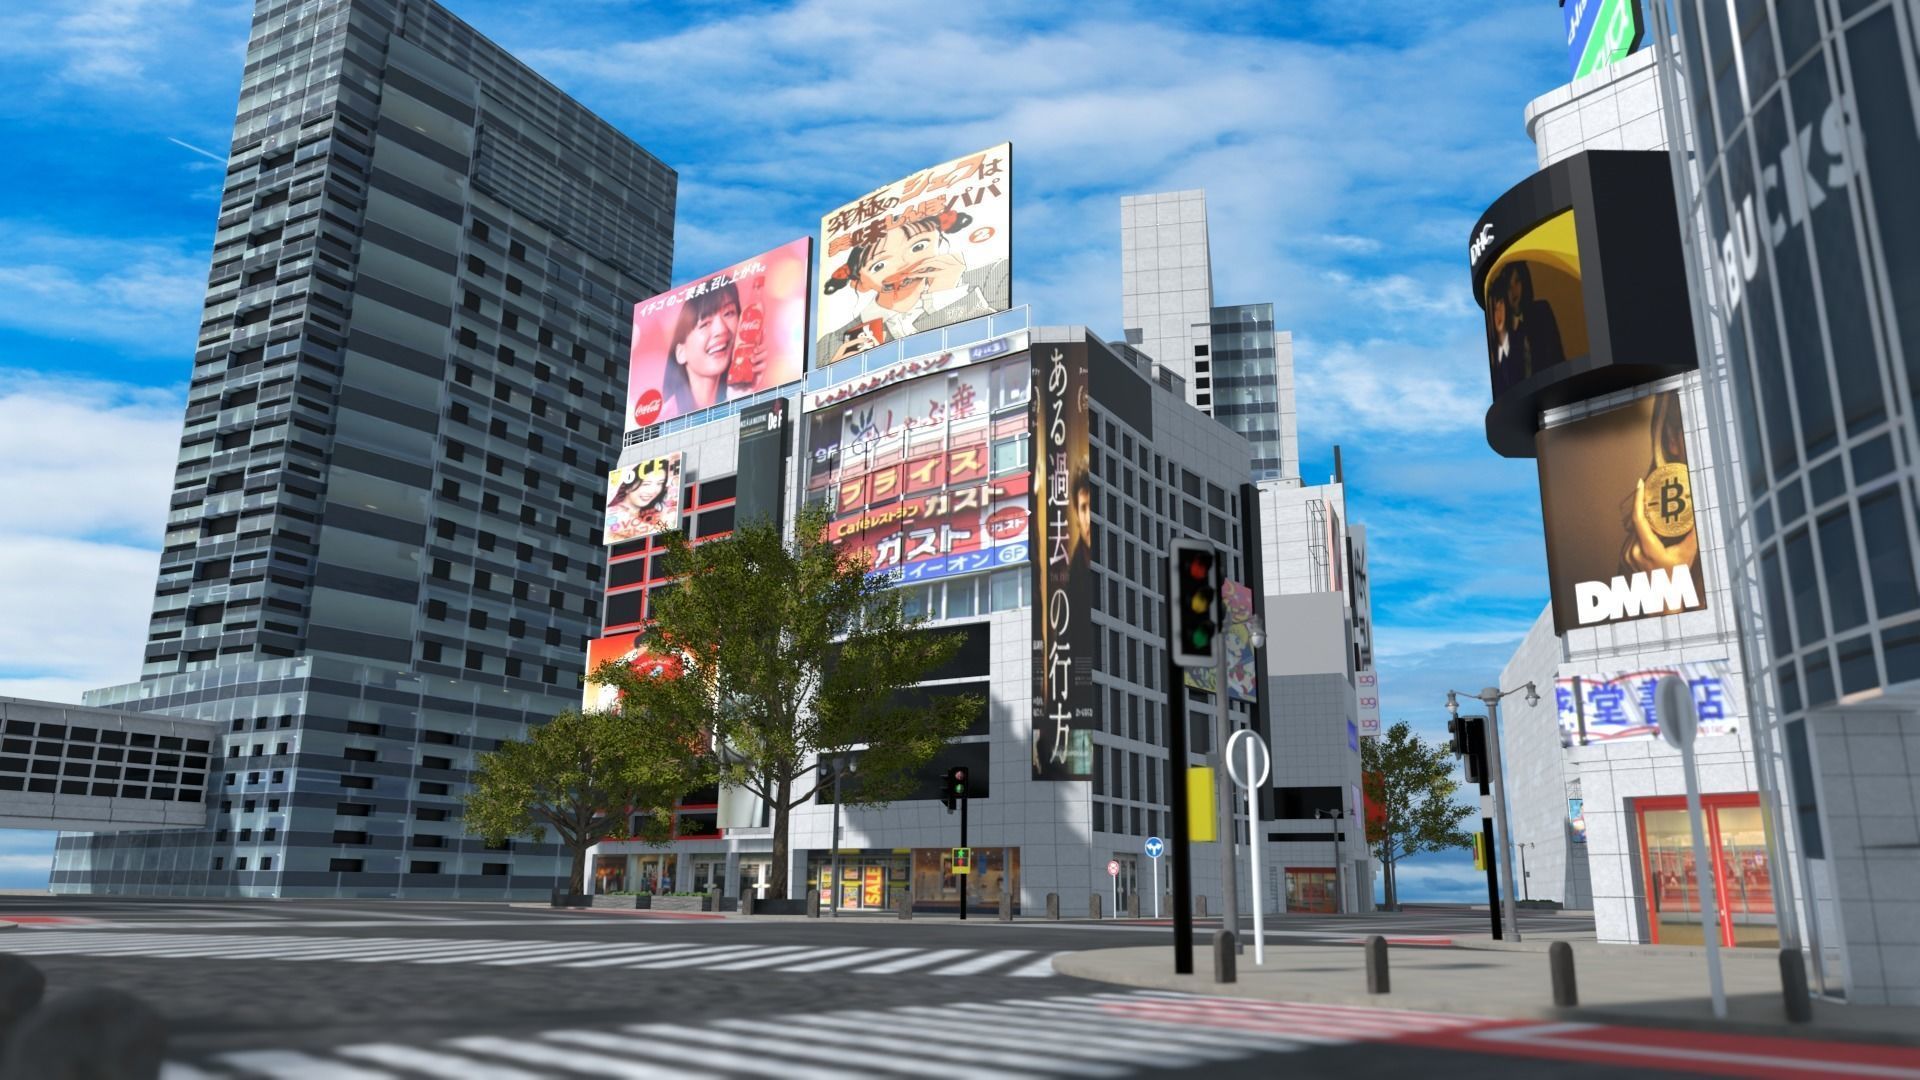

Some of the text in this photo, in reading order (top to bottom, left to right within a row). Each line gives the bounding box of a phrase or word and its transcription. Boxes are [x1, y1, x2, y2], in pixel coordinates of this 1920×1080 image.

[873, 525, 972, 569] ガスト
[1003, 549, 1025, 562] 6F
[1048, 348, 1073, 765] ある過去の行方
[1574, 564, 1699, 625] DMM
[865, 866, 881, 905] SALE
